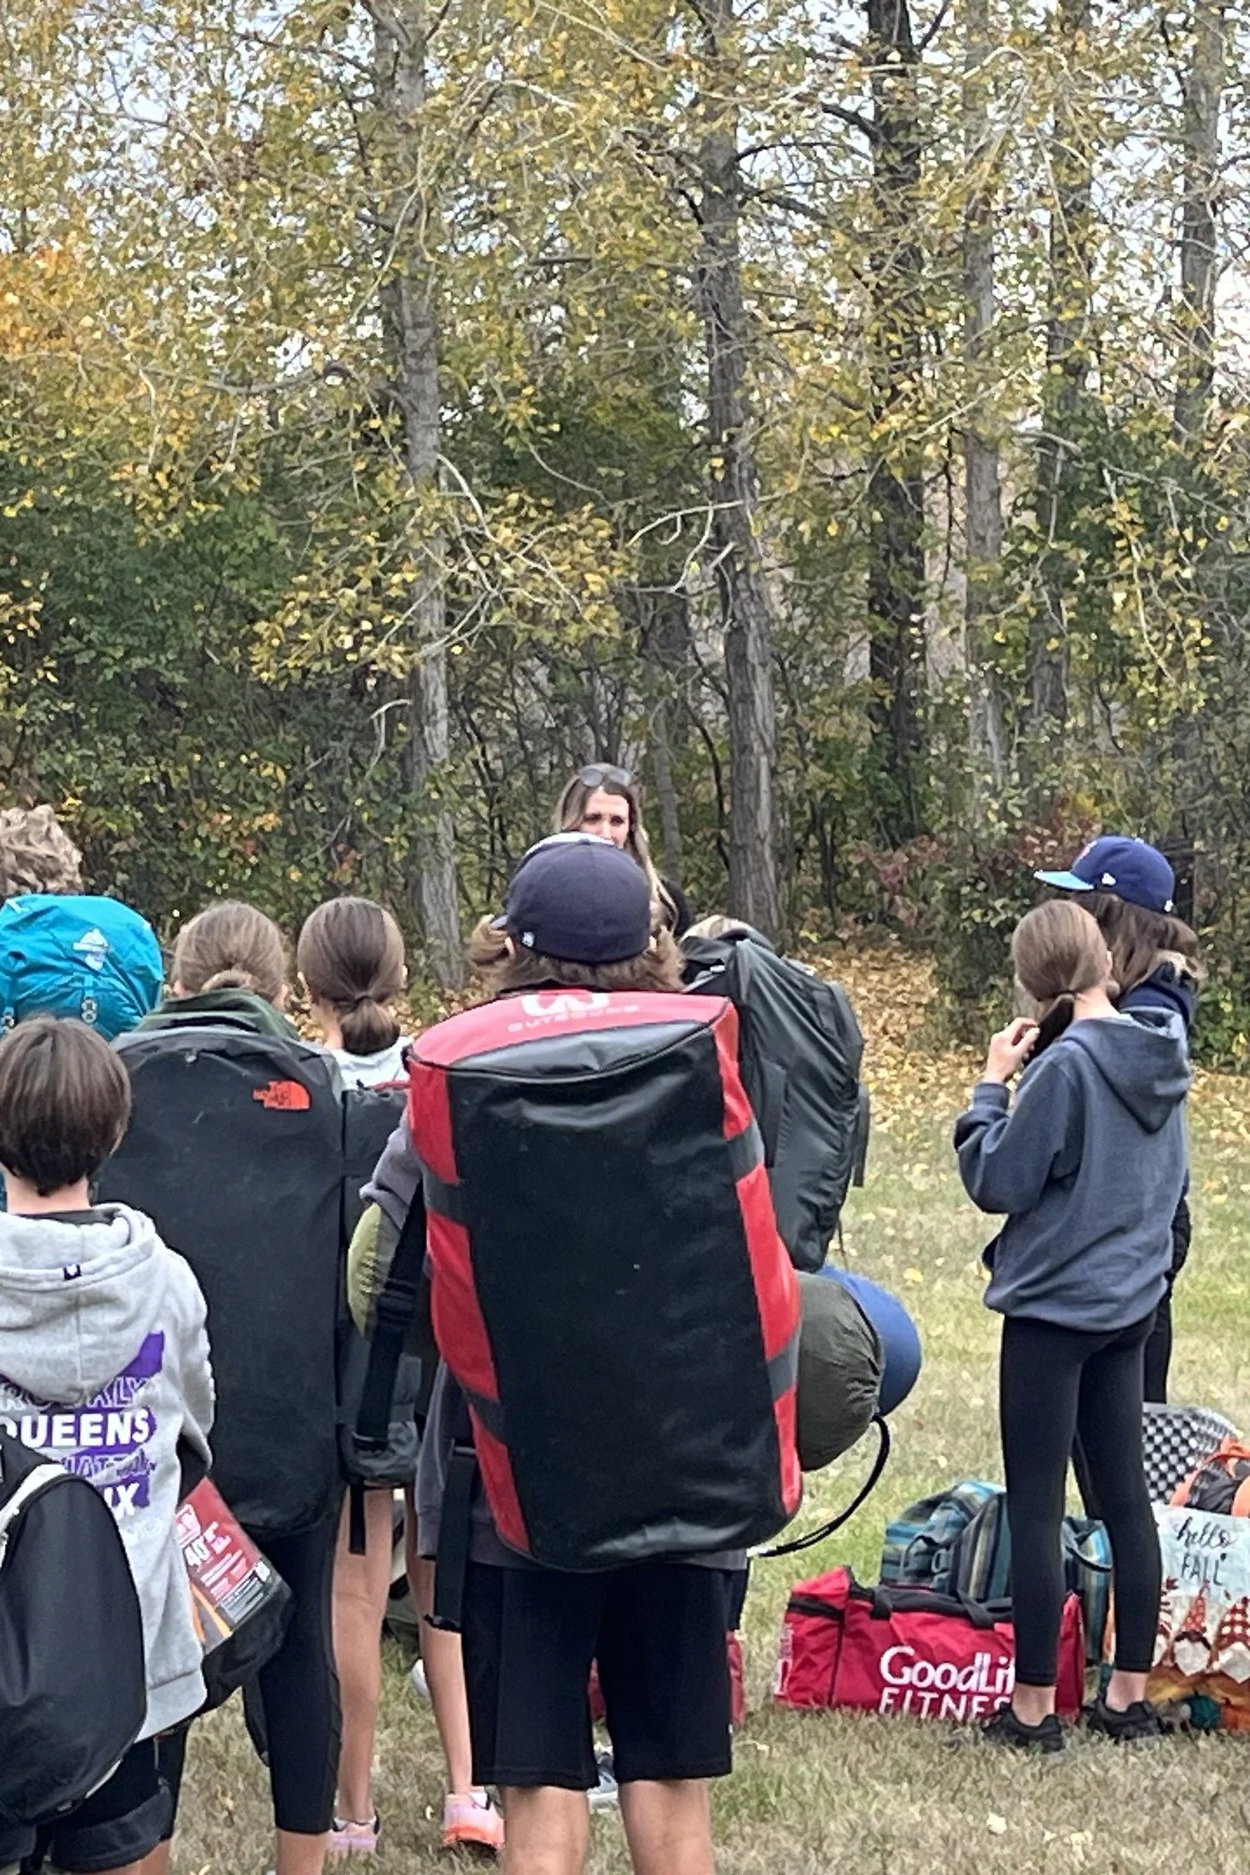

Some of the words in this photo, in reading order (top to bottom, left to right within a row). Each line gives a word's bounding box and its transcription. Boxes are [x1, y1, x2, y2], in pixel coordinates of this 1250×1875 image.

[1173, 1516, 1238, 1549] hello
[1180, 1552, 1223, 1586] FALL
[879, 1645, 1015, 1695] GoodLif
